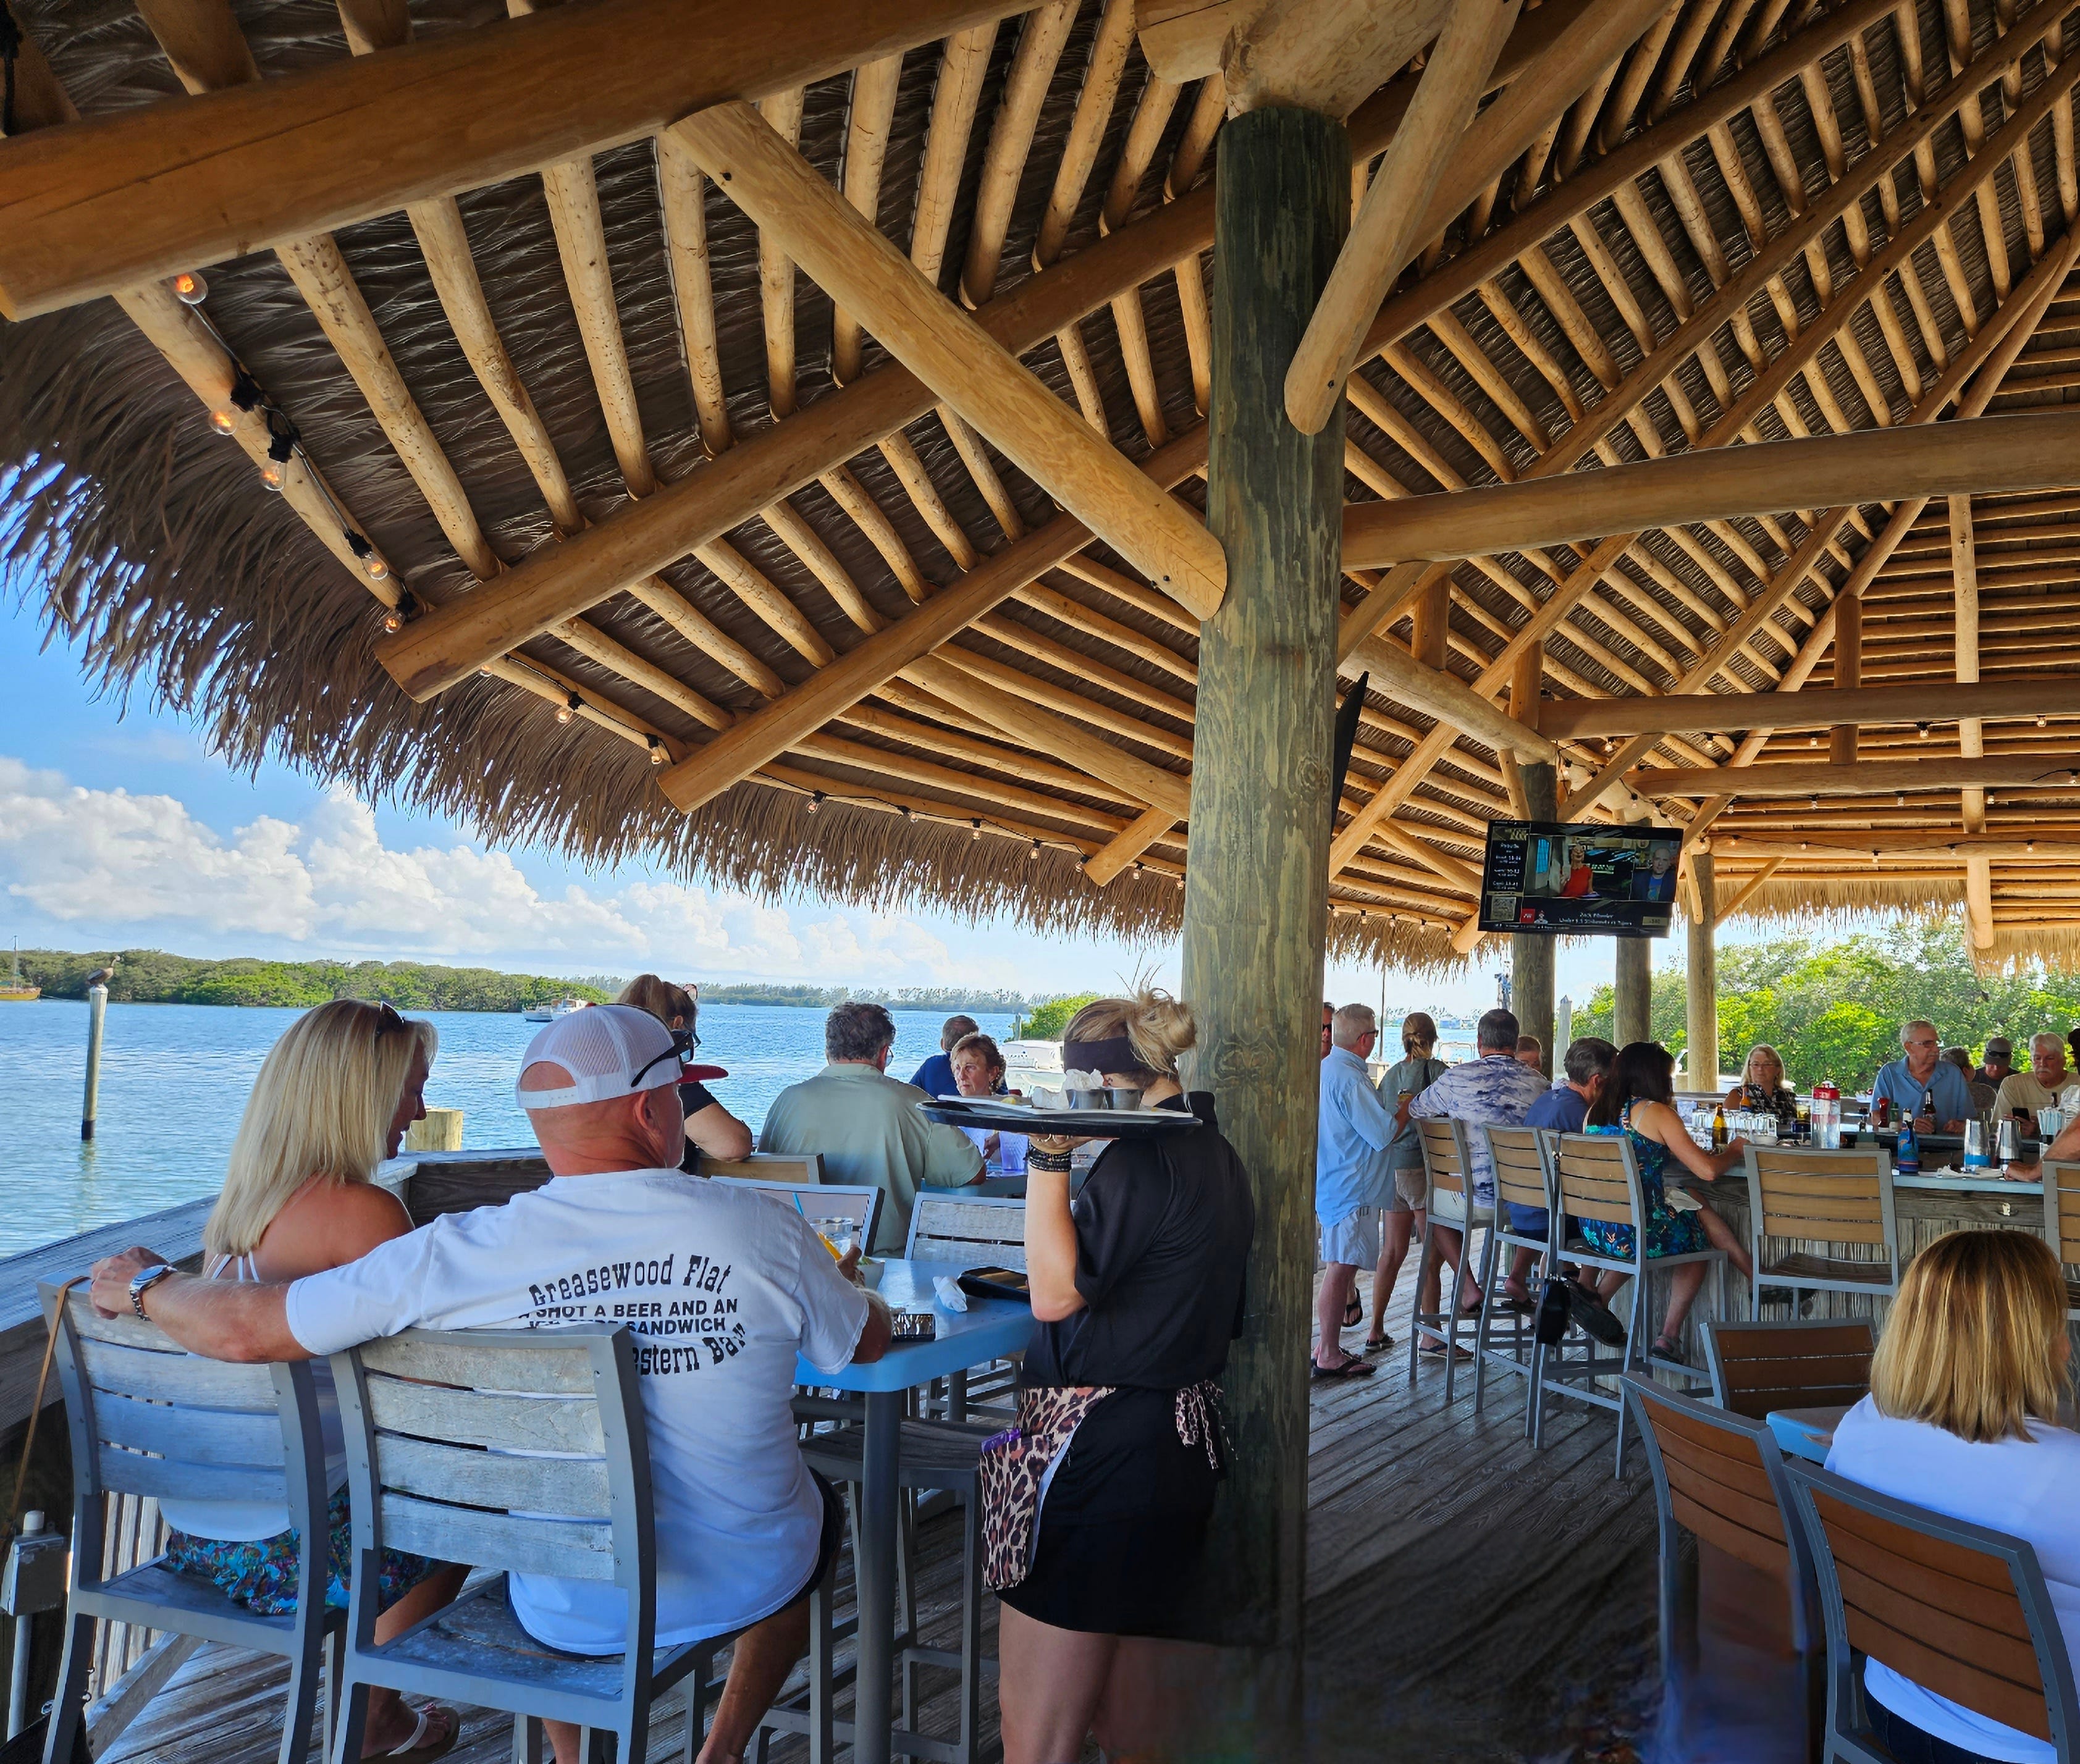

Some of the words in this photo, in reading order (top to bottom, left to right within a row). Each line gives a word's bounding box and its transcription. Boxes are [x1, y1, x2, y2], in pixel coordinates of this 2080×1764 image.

[529, 1254, 674, 1306] Greasewood
[683, 1254, 731, 1294] Flat
[536, 1305, 587, 1319] SHOT
[594, 1304, 607, 1317] A
[613, 1303, 662, 1317] BEER
[668, 1300, 707, 1316] AND
[713, 1298, 738, 1314] AN
[626, 1317, 726, 1335] SANDWICH
[633, 1345, 700, 1376] estern
